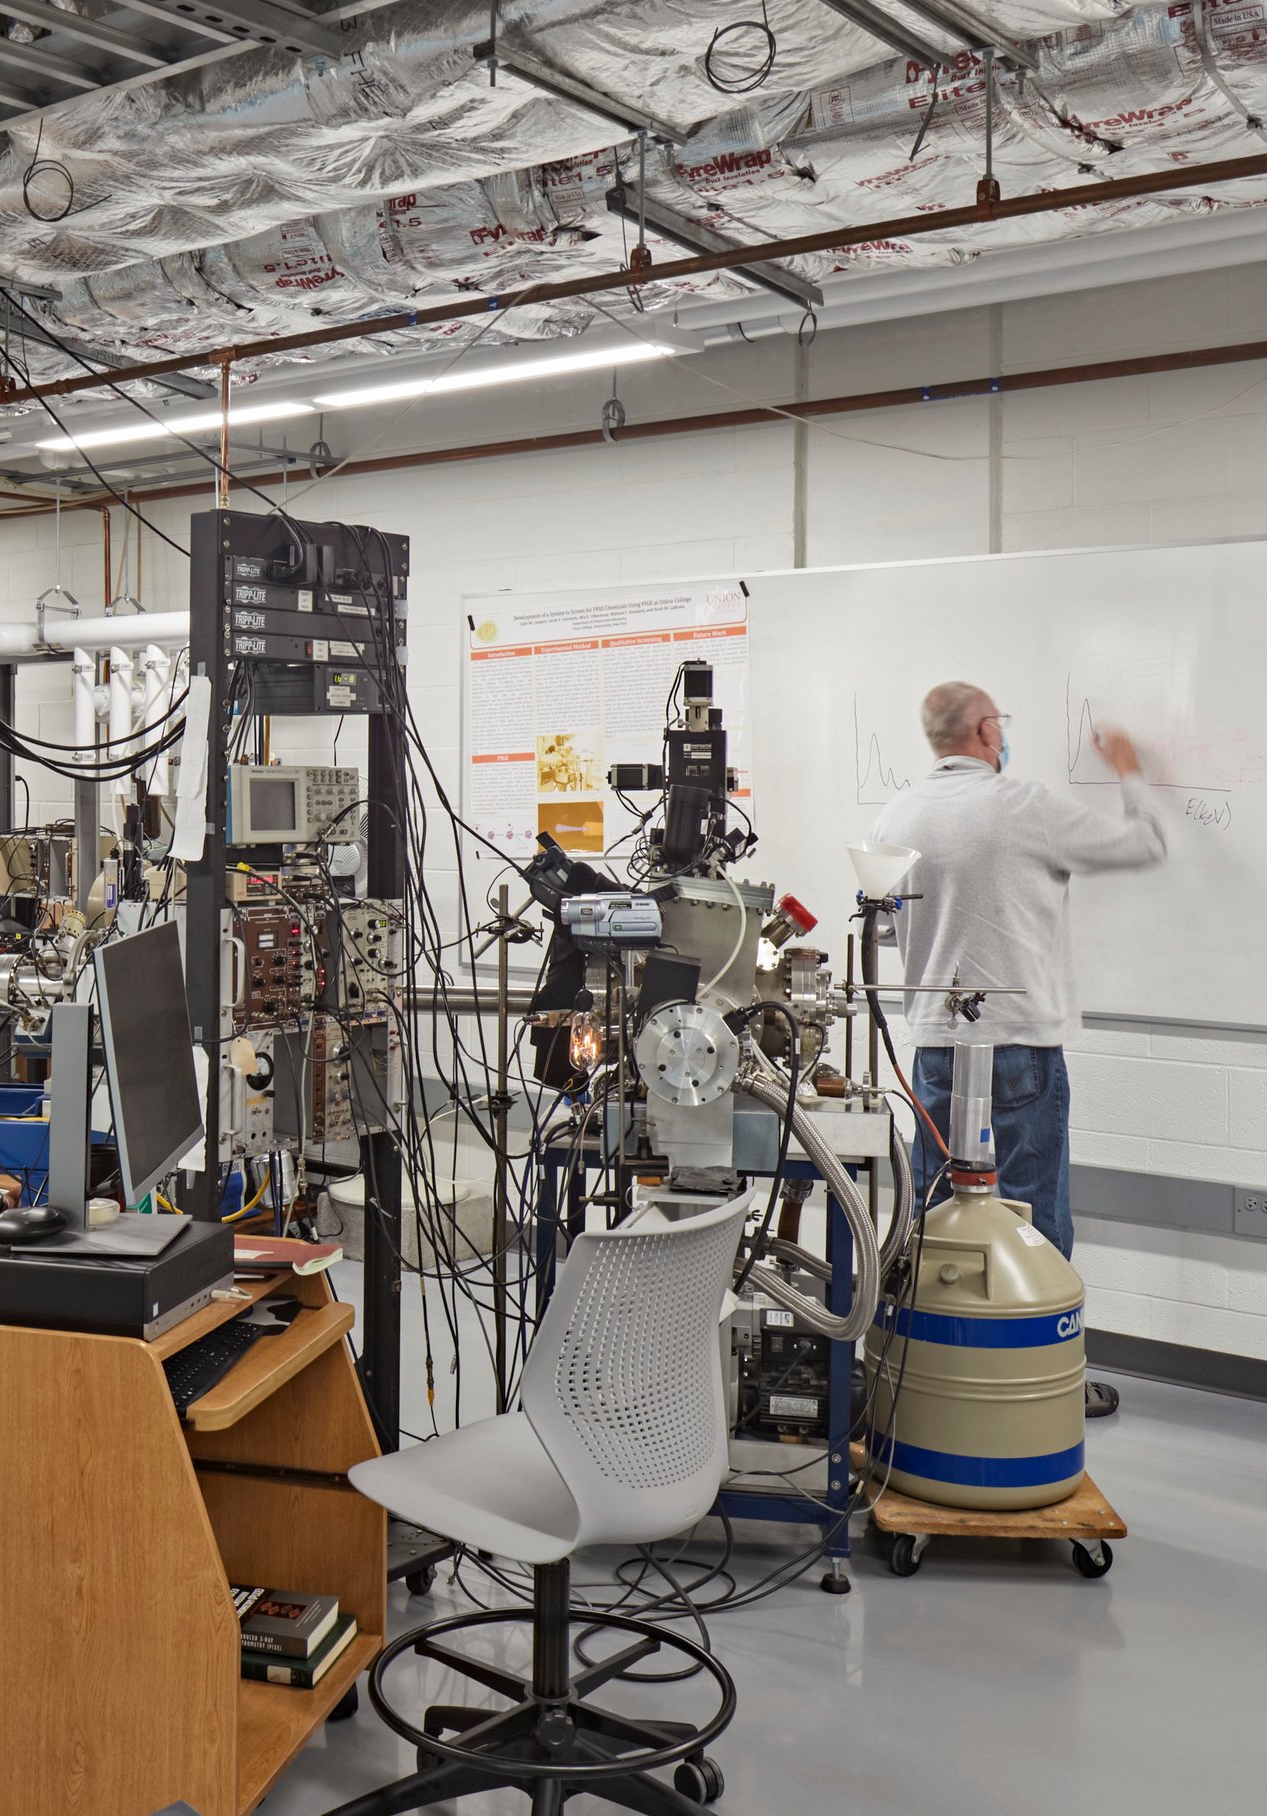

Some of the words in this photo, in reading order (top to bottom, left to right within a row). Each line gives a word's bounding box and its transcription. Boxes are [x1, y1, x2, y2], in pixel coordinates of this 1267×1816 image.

[1214, 17, 1233, 25] Made
[1243, 11, 1260, 20] USA
[908, 80, 987, 110] Eite
[1080, 97, 1193, 133] yreWrap
[705, 176, 721, 185] Duct
[723, 168, 761, 181] Insulation
[236, 565, 261, 576] TRIPP-LITE
[235, 589, 266, 601] TRIPP-LITE
[706, 591, 741, 604] UNION
[514, 613, 540, 622] Development
[550, 610, 566, 618] System
[605, 603, 627, 611] Chemicals
[627, 601, 641, 610] Using
[674, 596, 692, 604] College
[235, 614, 266, 626] TRIPP-LITE
[694, 631, 711, 639] Future
[712, 629, 727, 637] Work
[235, 639, 266, 652] TRIPP-LITE
[609, 638, 636, 647] Qualitative
[636, 636, 662, 644] Screening
[487, 651, 516, 659] Introduction
[540, 645, 572, 653] Experimental
